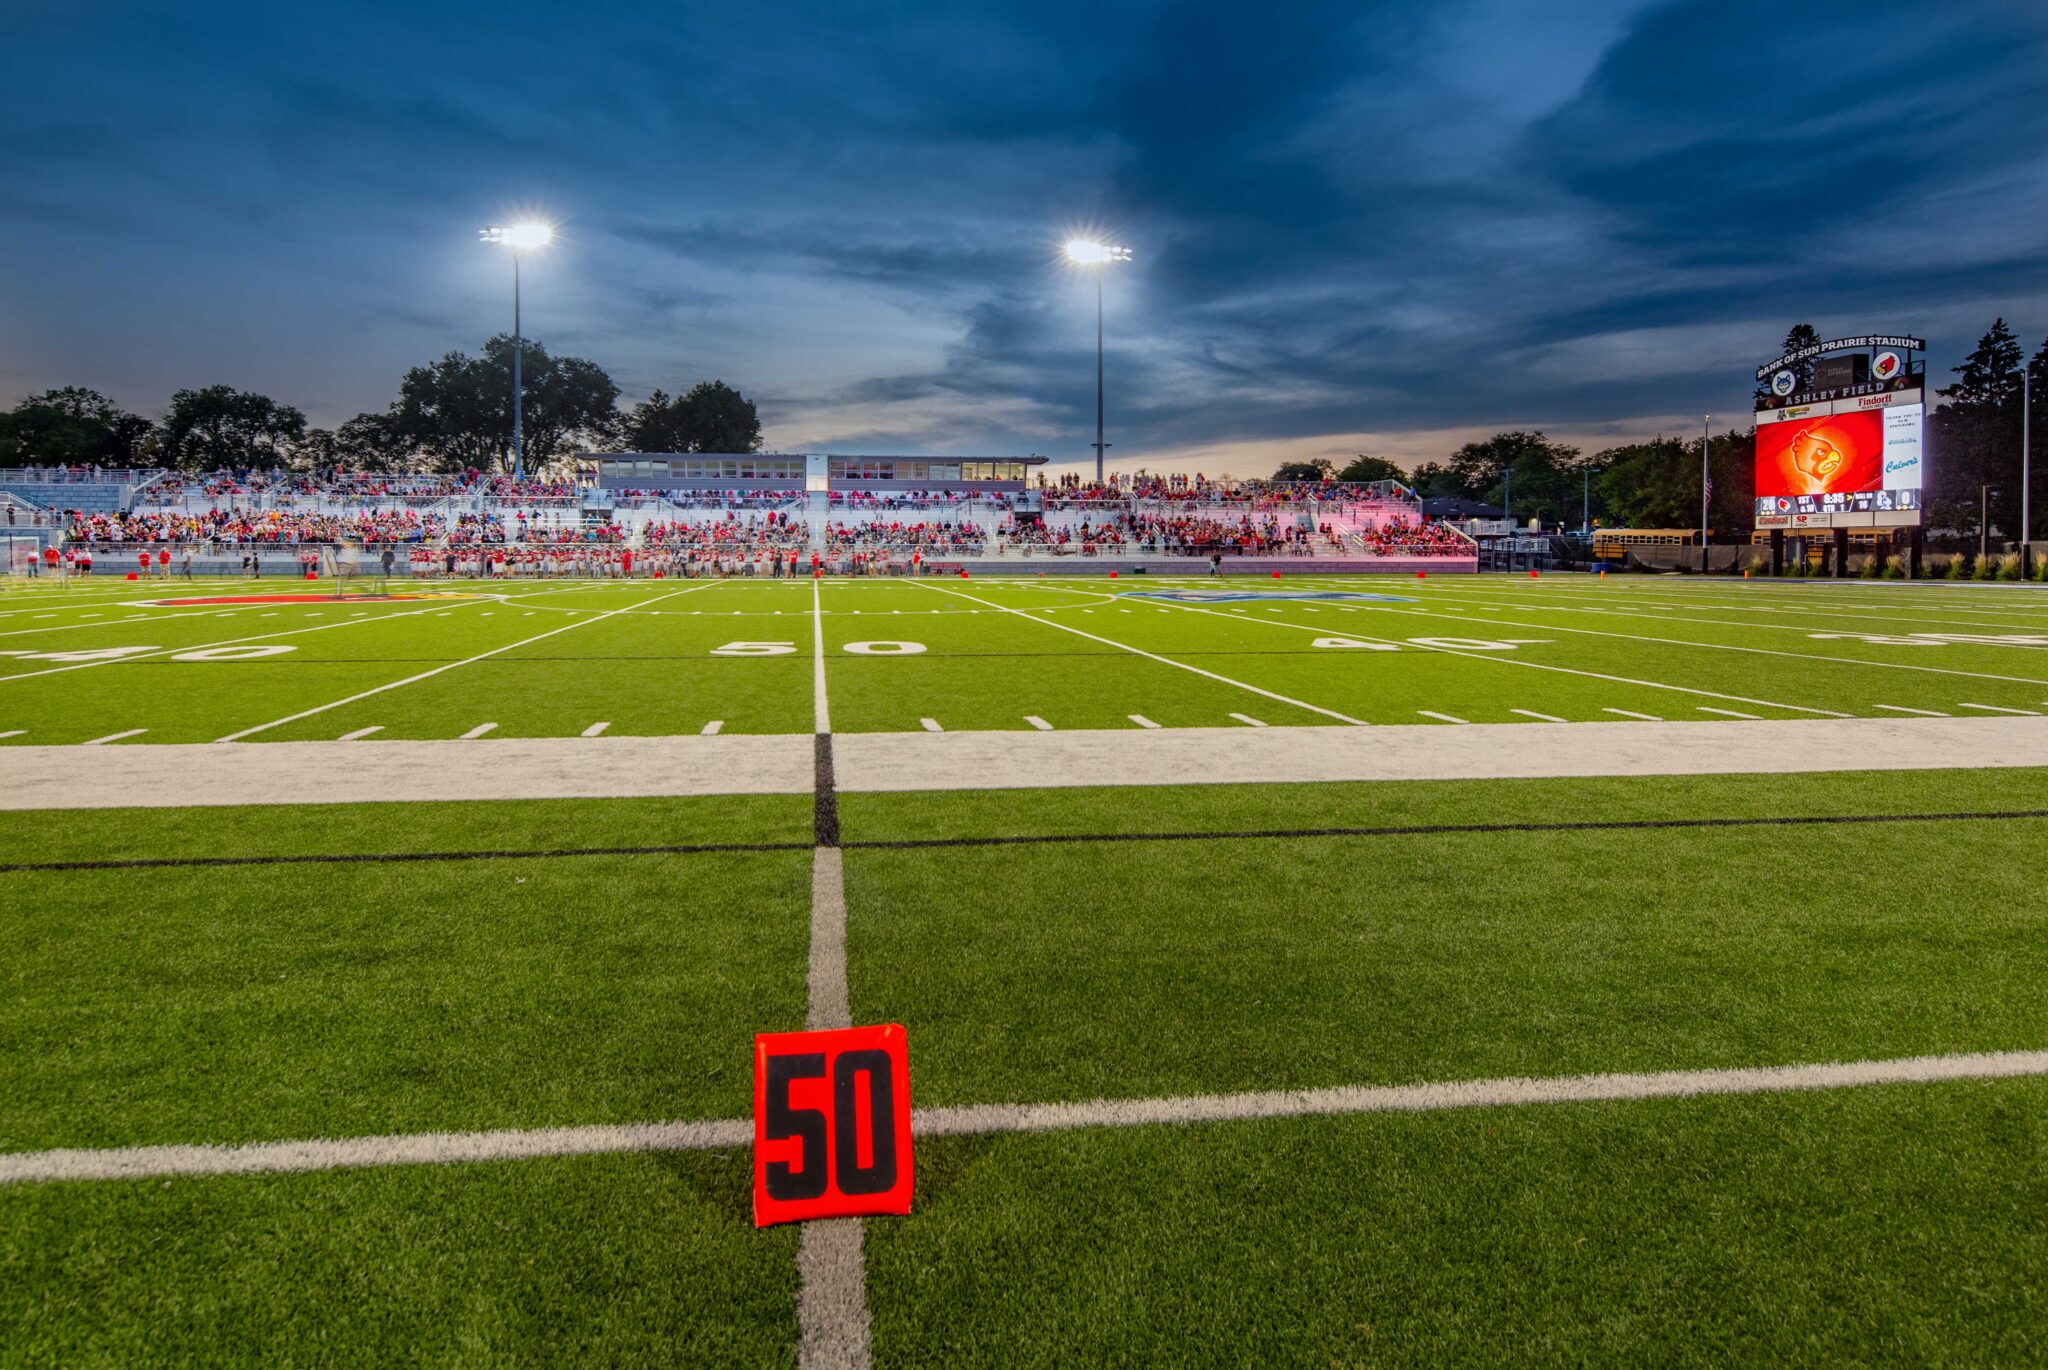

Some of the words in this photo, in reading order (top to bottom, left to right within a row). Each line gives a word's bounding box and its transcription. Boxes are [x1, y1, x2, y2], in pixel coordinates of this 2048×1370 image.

[1757, 358, 1784, 378] BANK
[1784, 352, 1797, 365] OF
[1798, 345, 1820, 359] SUN
[1821, 337, 1867, 352] PRAIRIE
[1868, 336, 1920, 349] STADIUM
[1785, 389, 1836, 405] ASHLEY
[1842, 382, 1884, 397] FIELD
[1857, 393, 1892, 407] Findorff
[709, 640, 927, 656] 50
[1311, 637, 1519, 651] 40
[765, 1049, 897, 1201] 50
